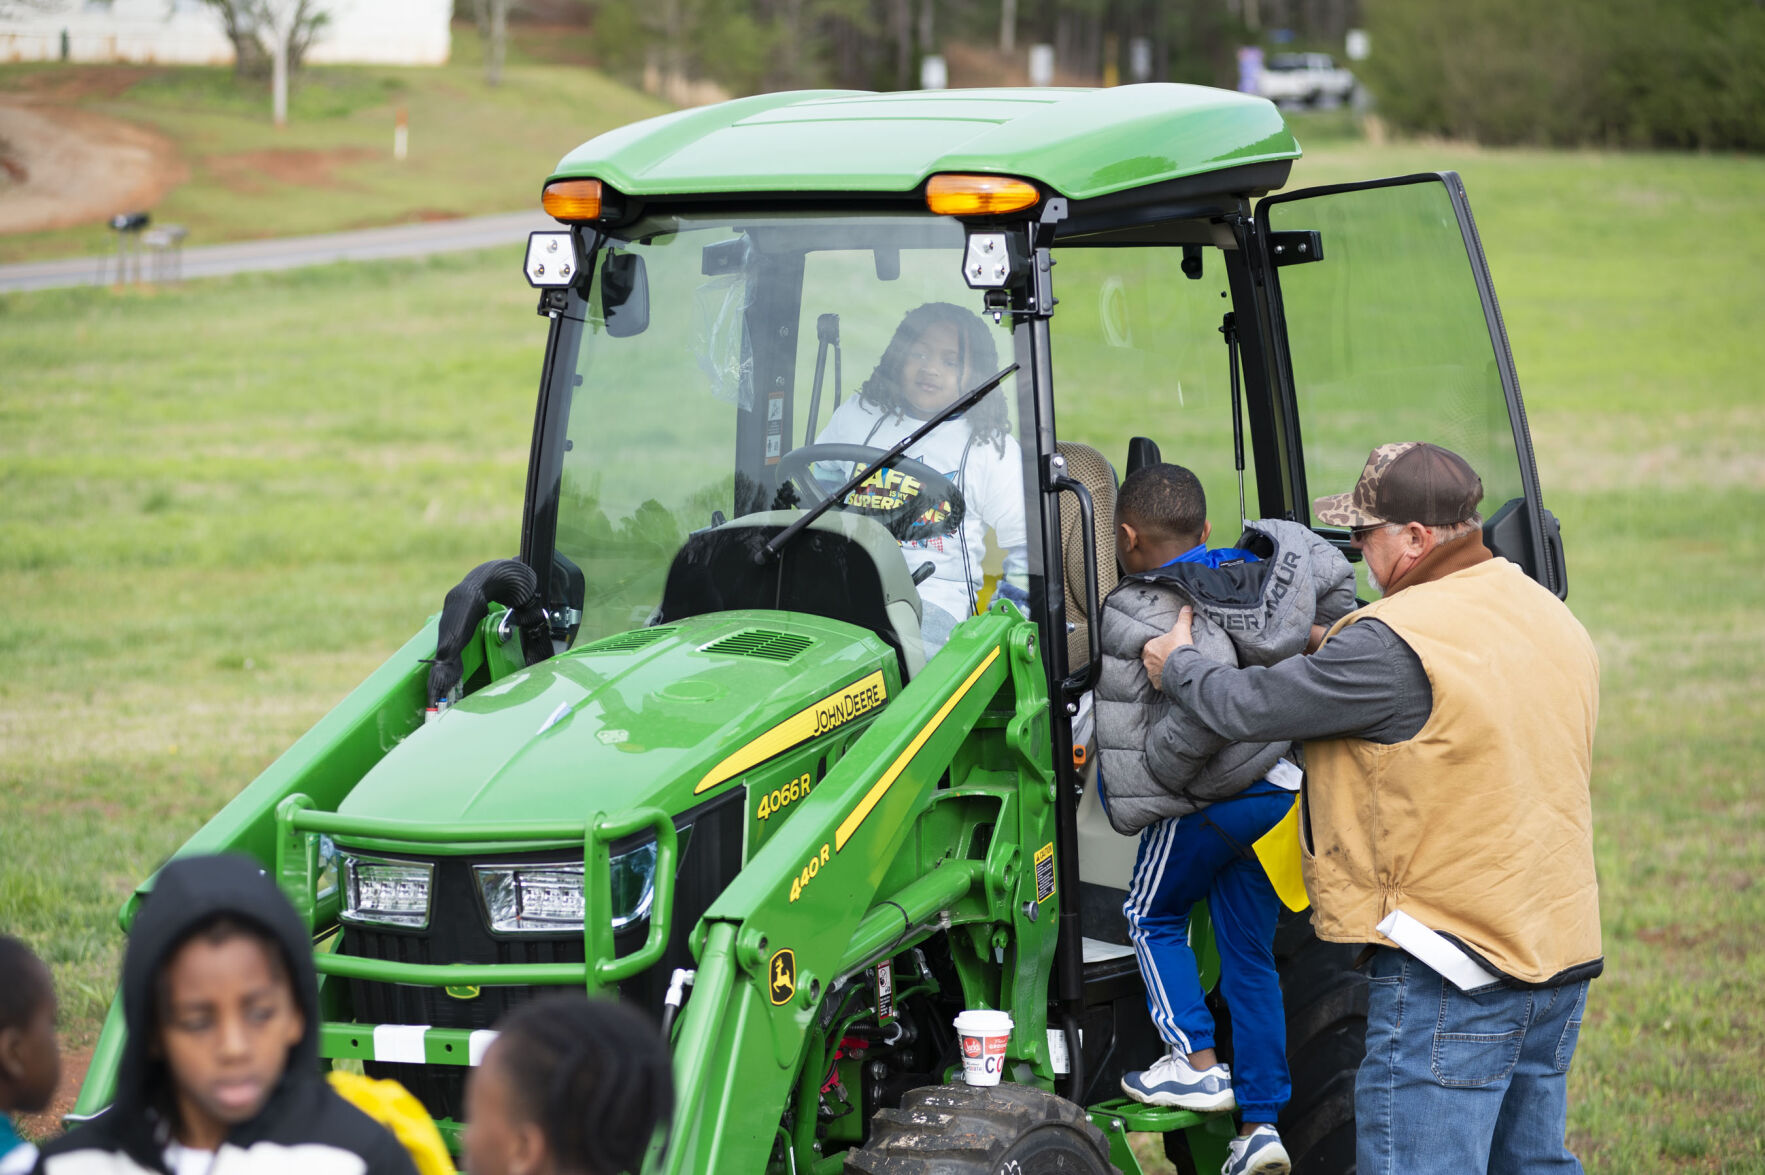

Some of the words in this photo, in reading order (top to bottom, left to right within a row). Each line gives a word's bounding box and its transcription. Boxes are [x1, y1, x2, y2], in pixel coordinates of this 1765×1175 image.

[1203, 608, 1260, 631] DER
[814, 703, 844, 733] JOHN
[844, 684, 880, 717] DEERE
